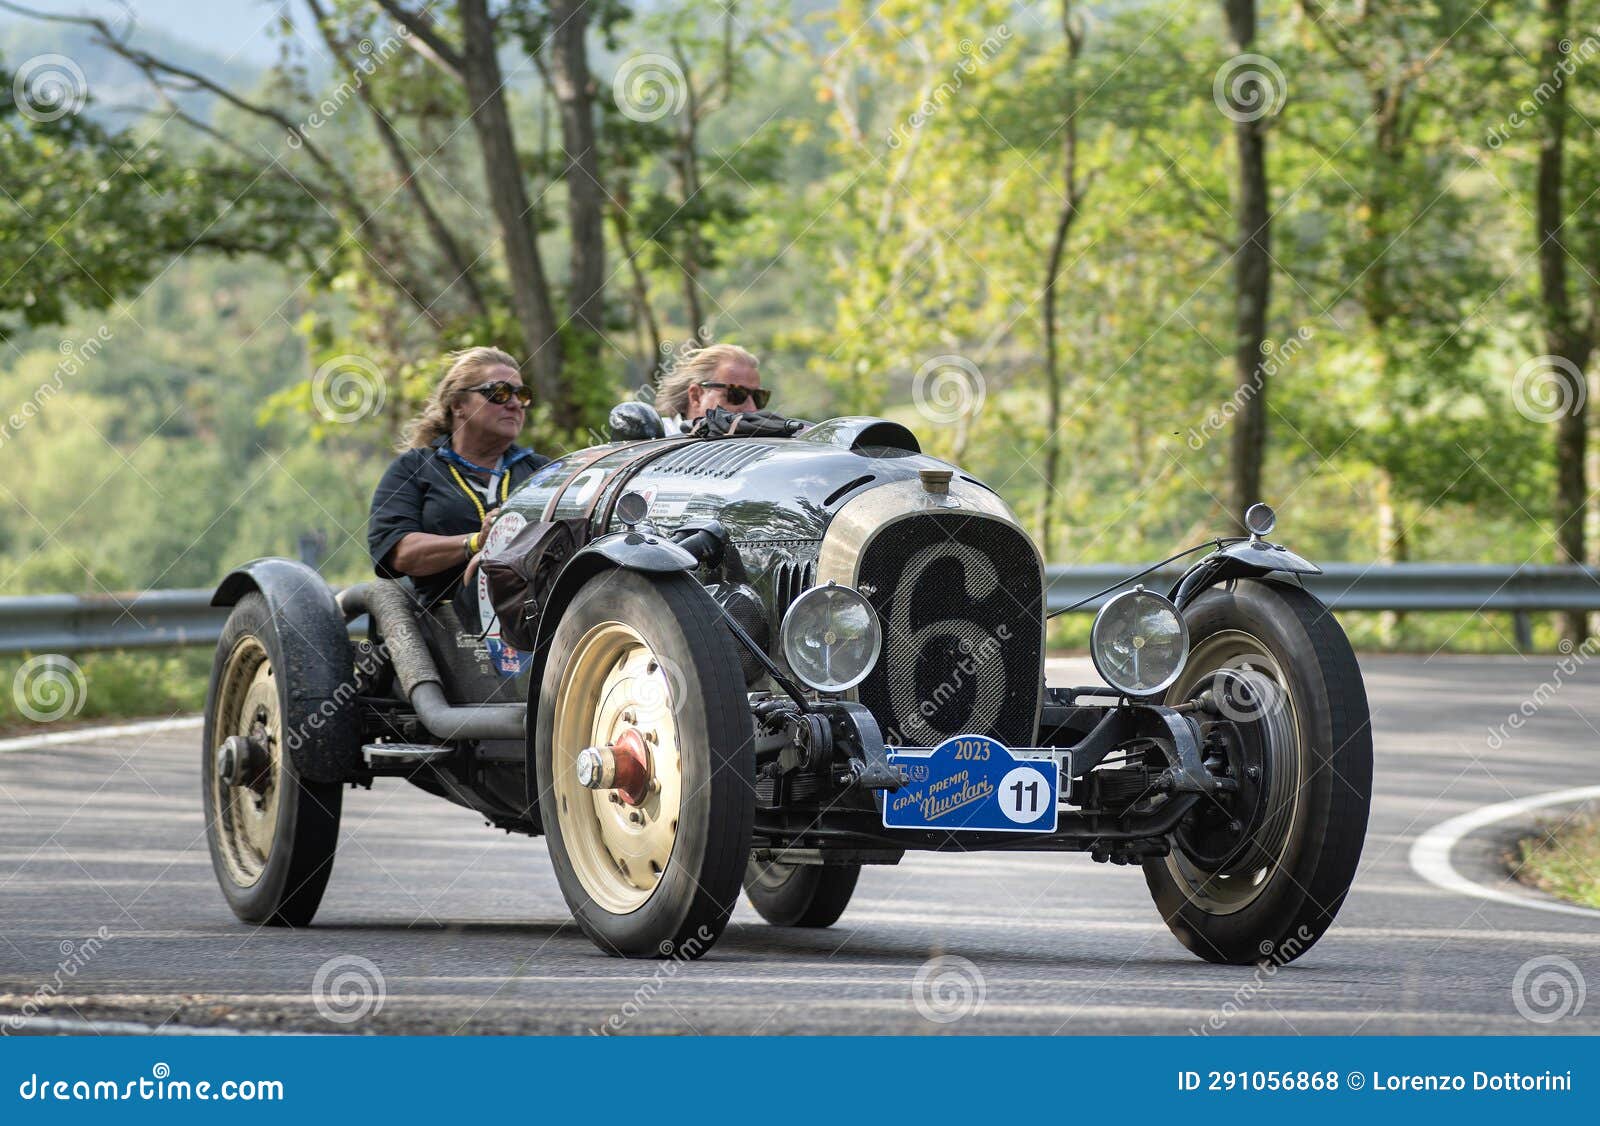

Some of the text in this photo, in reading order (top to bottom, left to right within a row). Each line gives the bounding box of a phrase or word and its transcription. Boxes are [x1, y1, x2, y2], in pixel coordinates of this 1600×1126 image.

[887, 539, 1007, 748] 6
[954, 741, 991, 761] 2023
[893, 789, 923, 811] GRAN
[929, 770, 969, 795] PREMIO
[919, 775, 994, 821] Nuvolari
[1010, 781, 1038, 812] 11
